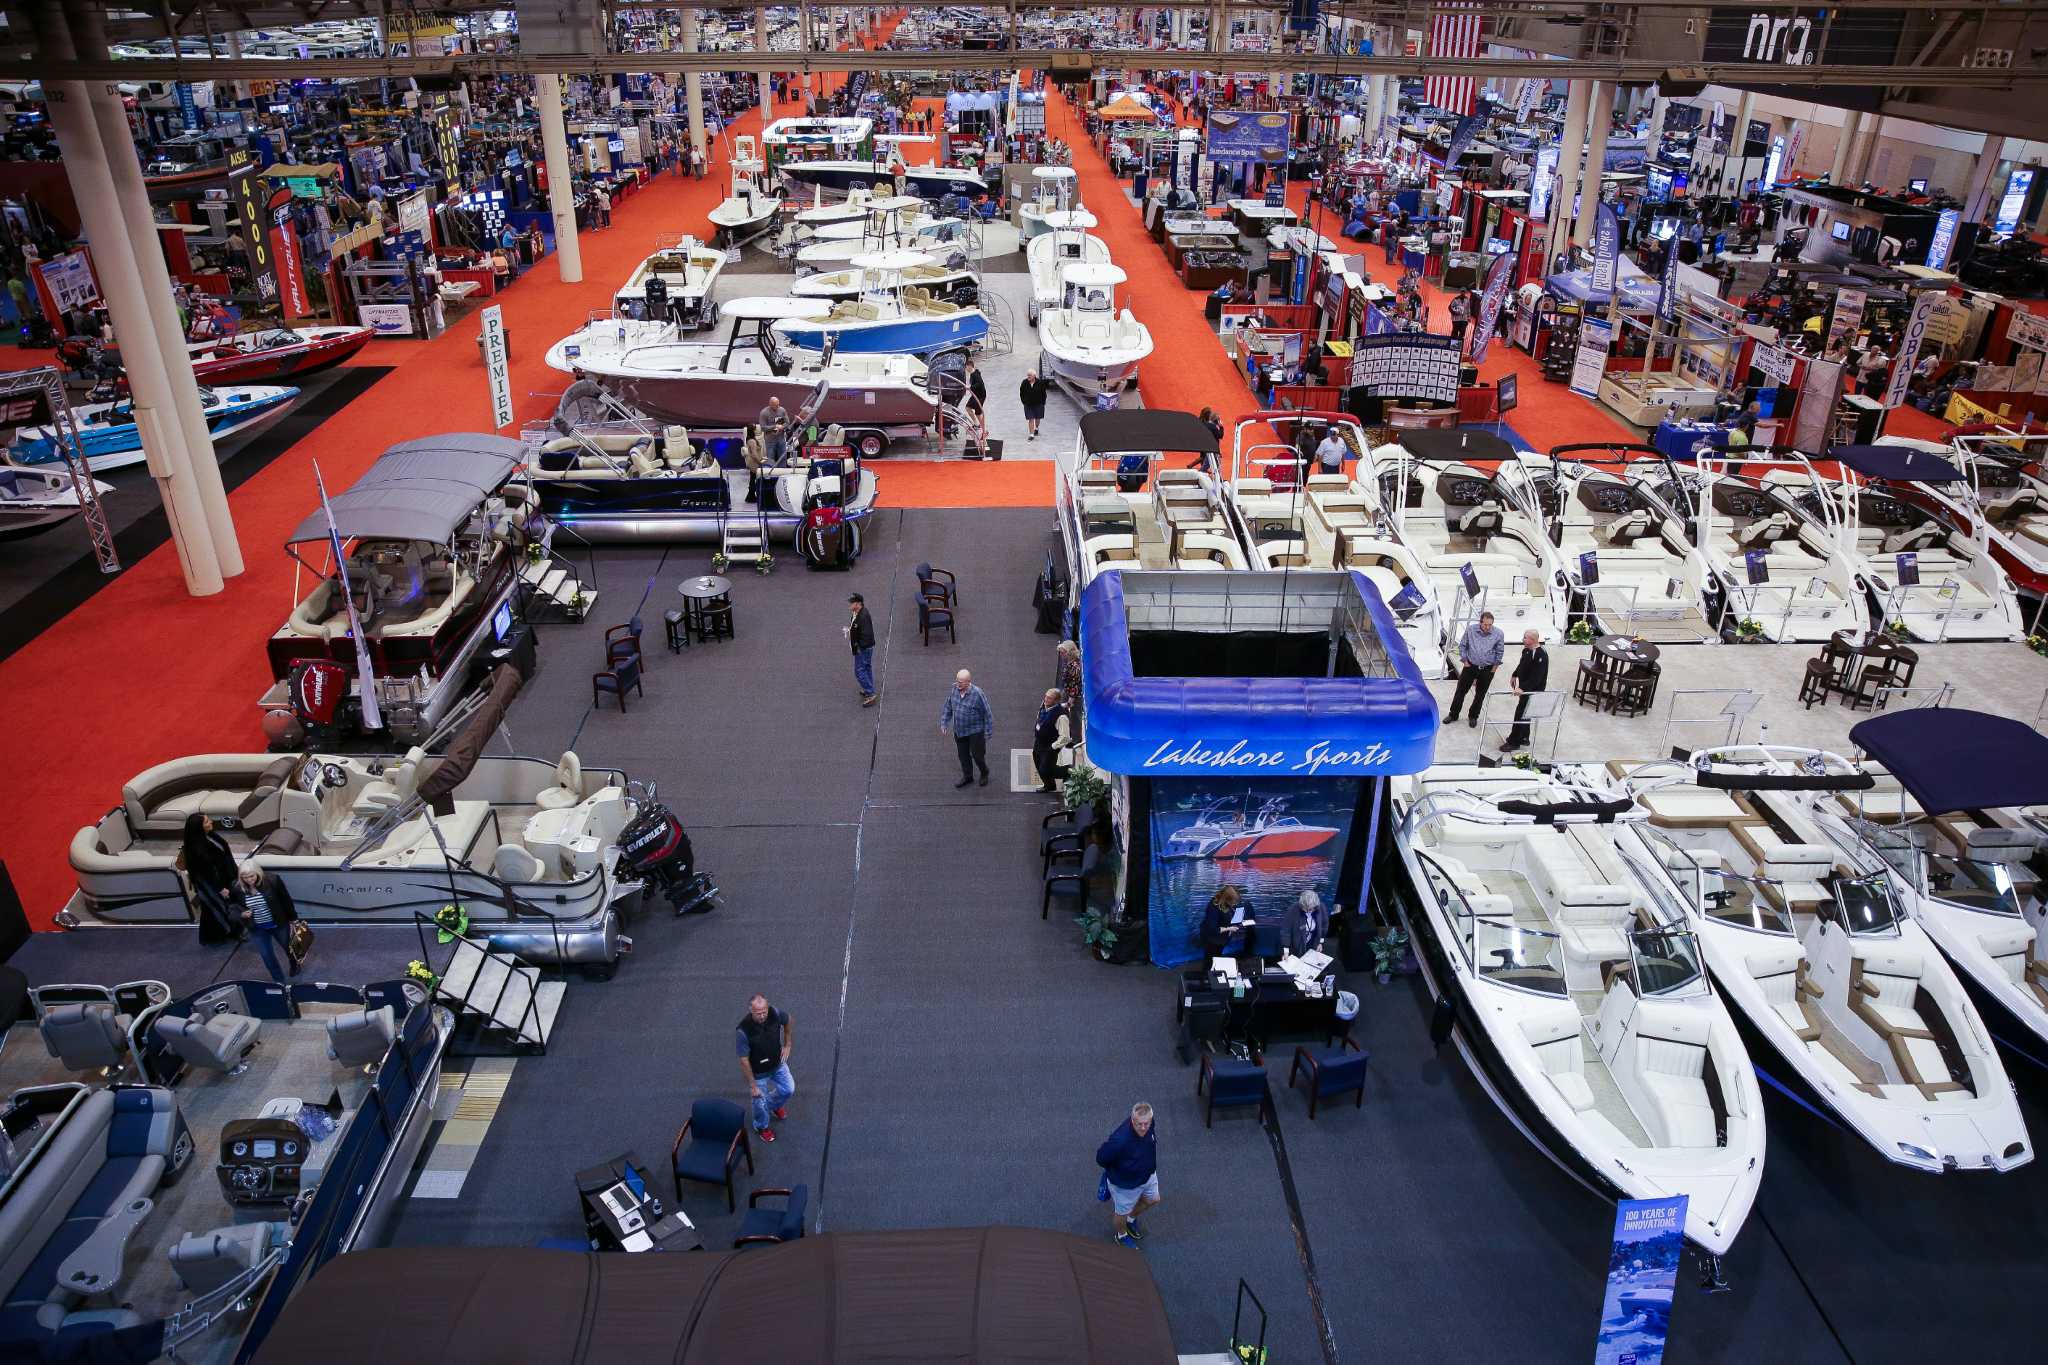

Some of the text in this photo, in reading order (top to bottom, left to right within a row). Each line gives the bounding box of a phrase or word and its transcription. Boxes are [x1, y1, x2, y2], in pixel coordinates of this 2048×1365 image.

[230, 149, 248, 167] AISLE
[1209, 146, 1257, 157] Sundance Spas
[241, 178, 265, 265] 4000
[256, 271, 272, 289] BOAT
[282, 229, 303, 314] NAUTIQUE
[1893, 303, 1930, 405] COBALT
[488, 319, 510, 426] PREMIER
[1143, 738, 1393, 775] Lakeshore Sports
[1623, 1217, 1677, 1232] INNOVATIONS
[1624, 1206, 1679, 1222] 100 YEARS OF
